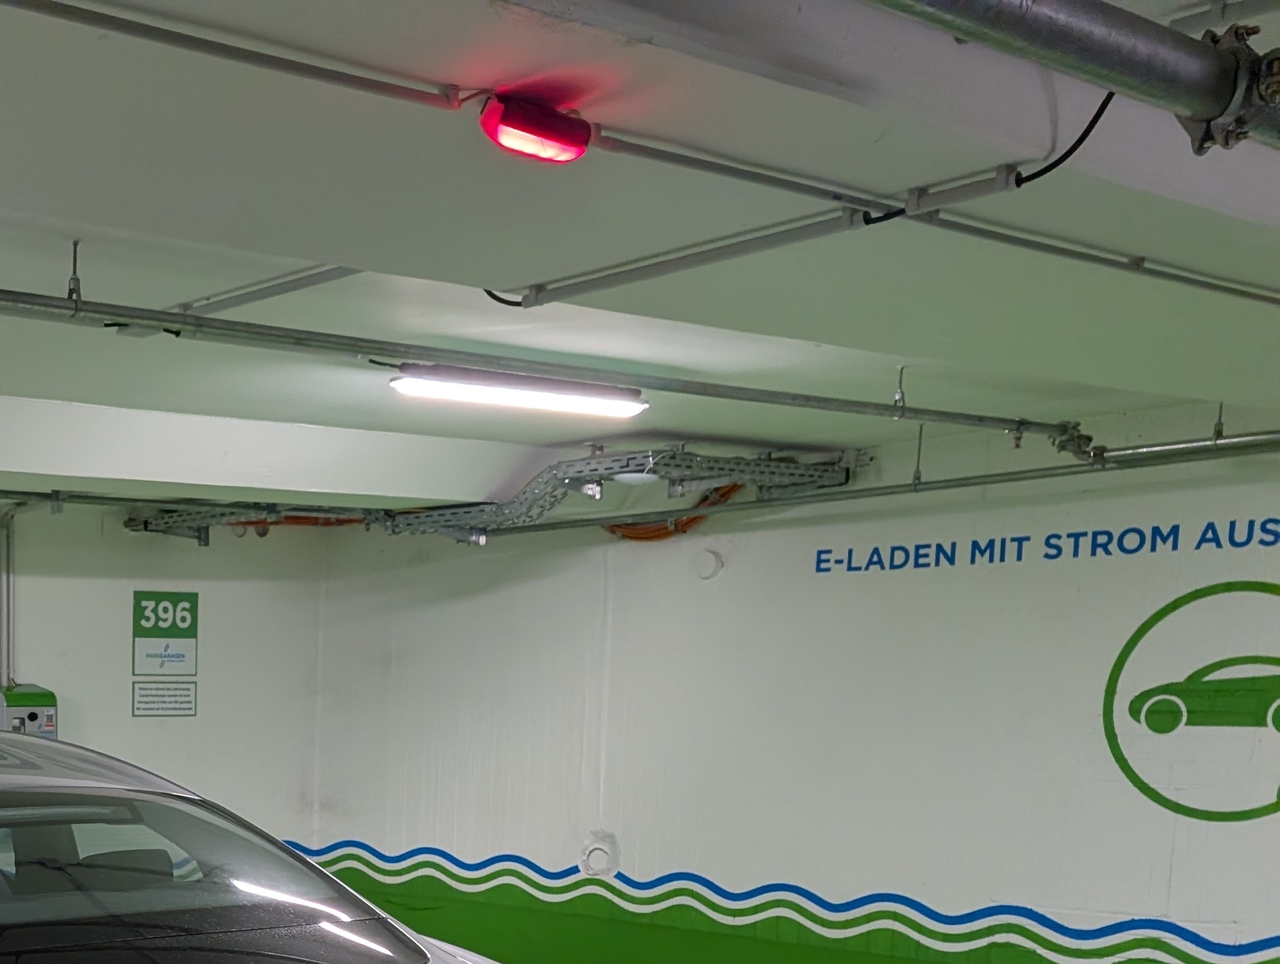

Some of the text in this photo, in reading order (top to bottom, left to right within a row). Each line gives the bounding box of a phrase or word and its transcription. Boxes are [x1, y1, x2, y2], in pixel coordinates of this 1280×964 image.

[815, 518, 1280, 573] E-LADEN MIT STROM AUS
[140, 600, 191, 628] 396
